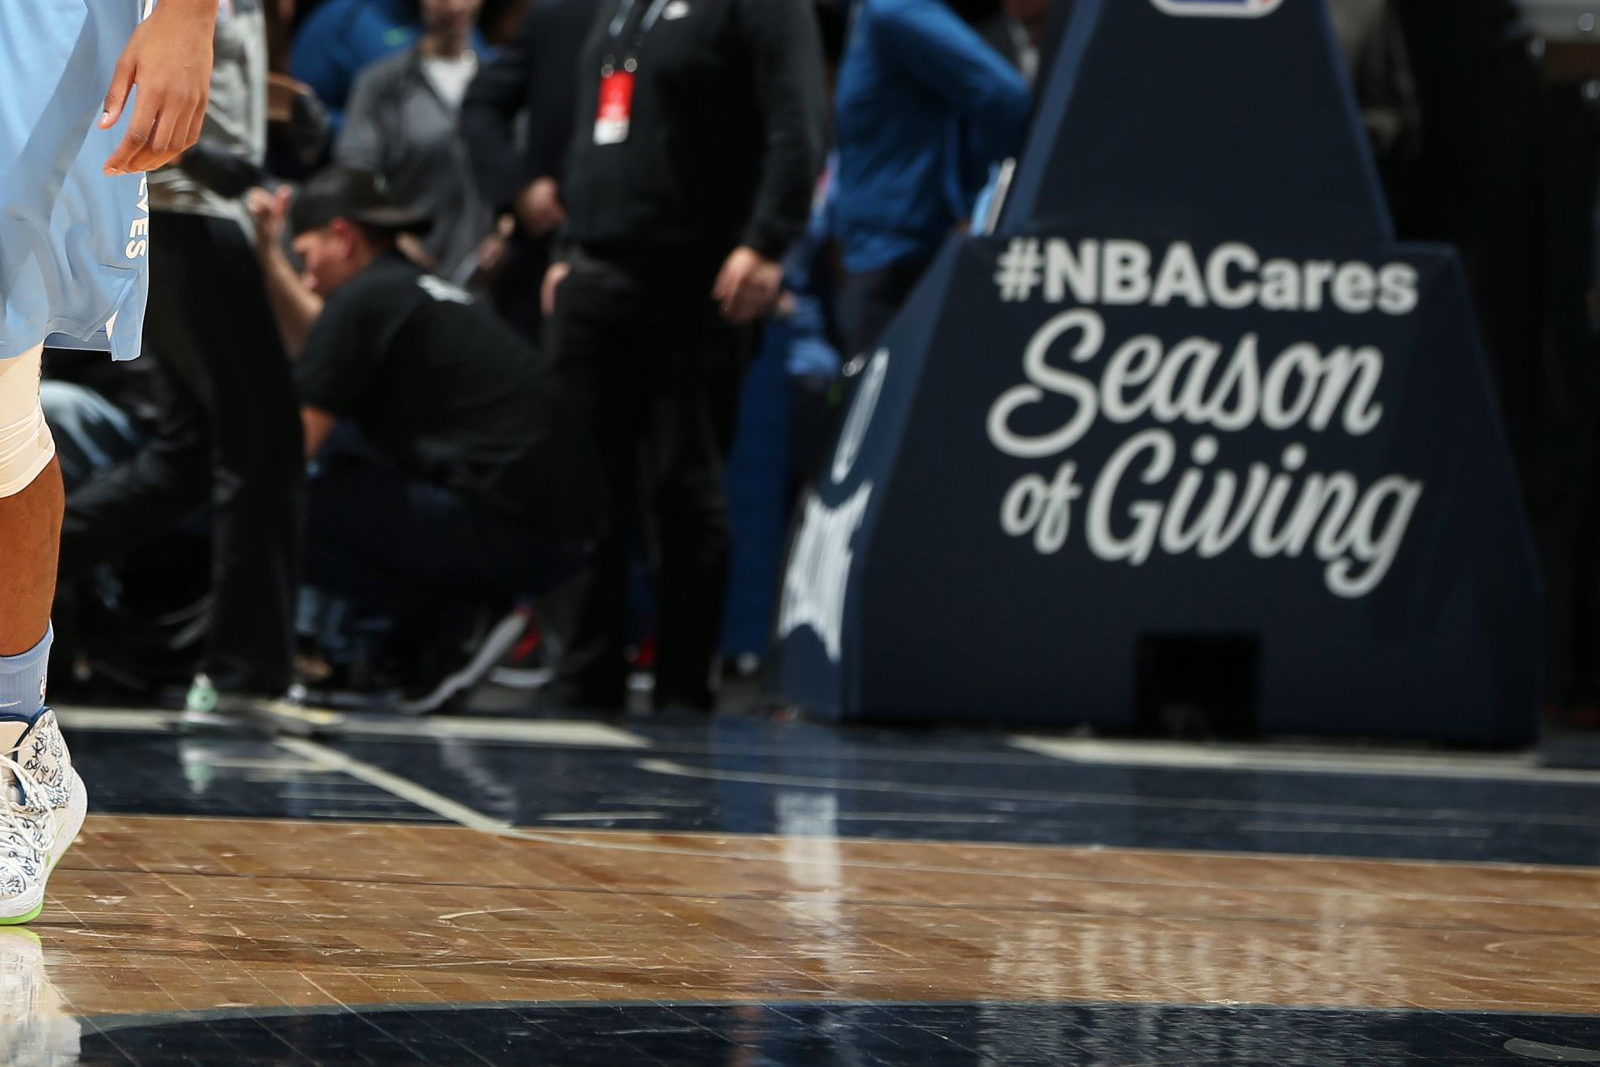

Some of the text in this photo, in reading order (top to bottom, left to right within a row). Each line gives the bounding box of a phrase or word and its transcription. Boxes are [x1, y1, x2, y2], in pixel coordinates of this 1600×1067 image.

[125, 171, 149, 259] LVES
[995, 237, 1419, 315] #NBACares
[987, 308, 1384, 458] Season
[1001, 428, 1424, 598] of Giving
